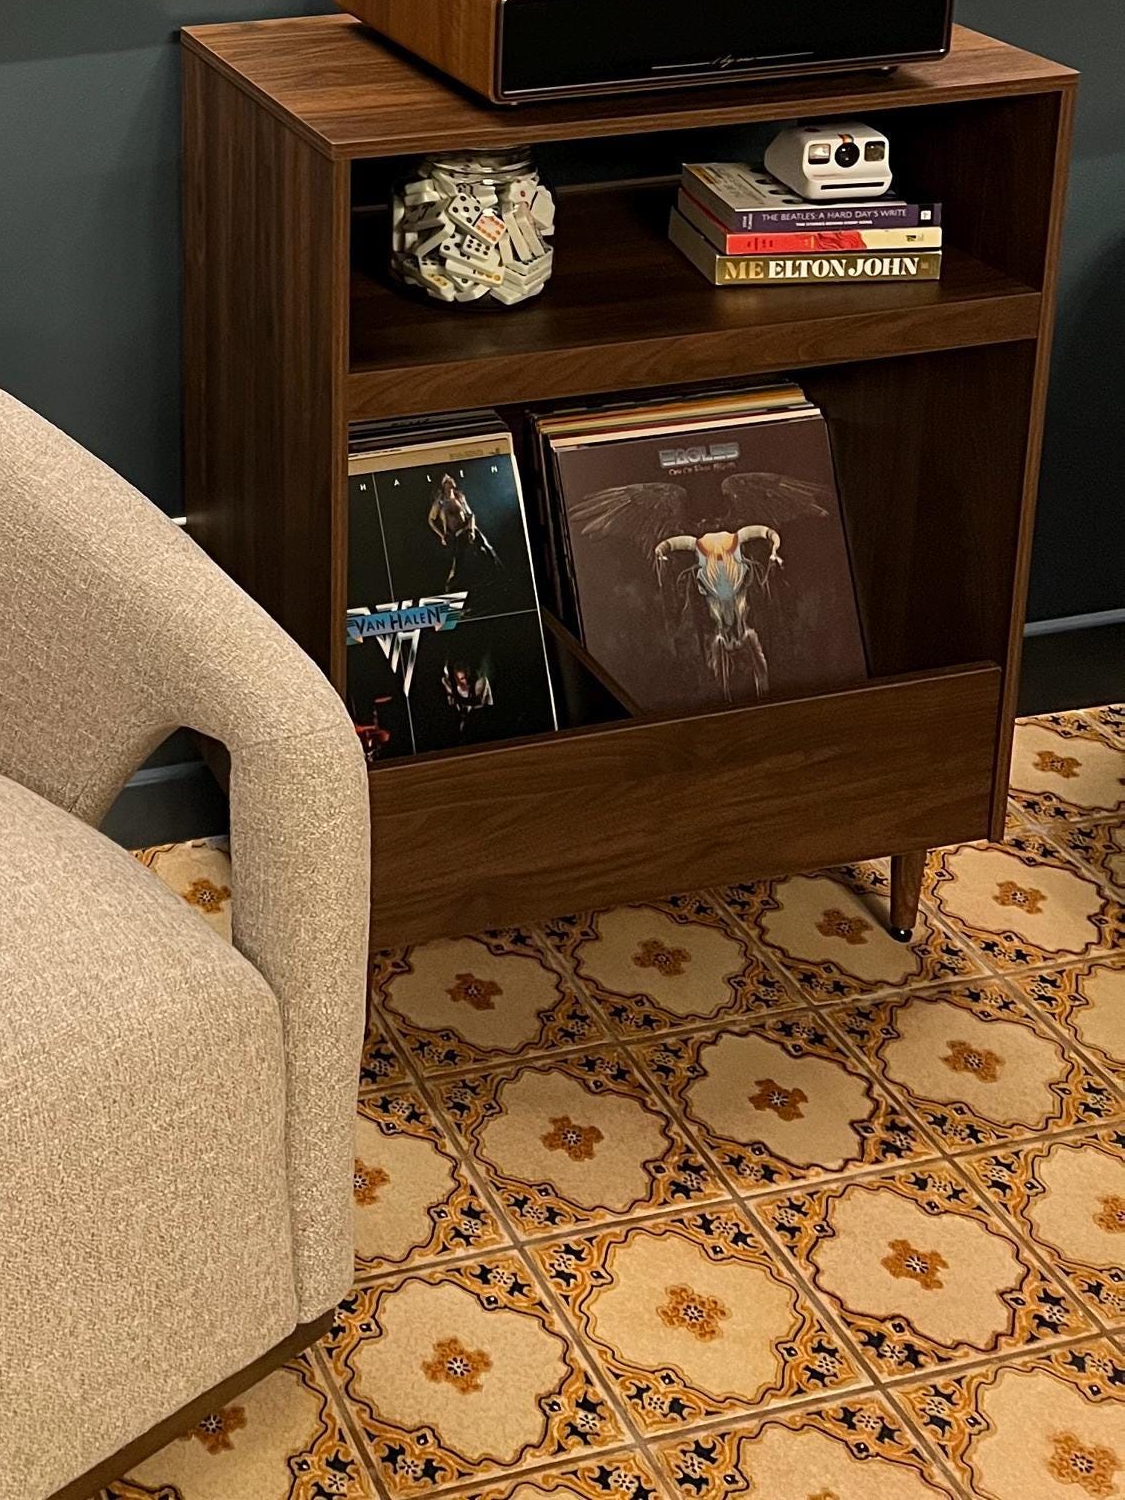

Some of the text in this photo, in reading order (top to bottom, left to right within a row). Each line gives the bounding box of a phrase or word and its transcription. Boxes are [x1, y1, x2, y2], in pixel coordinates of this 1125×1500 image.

[762, 213, 778, 221] THE
[818, 211, 825, 219] A
[827, 210, 852, 219] HARD
[880, 208, 907, 217] WRITE
[725, 257, 920, 280] ME ELTON JOHN
[355, 606, 441, 635] VAN HALEN
